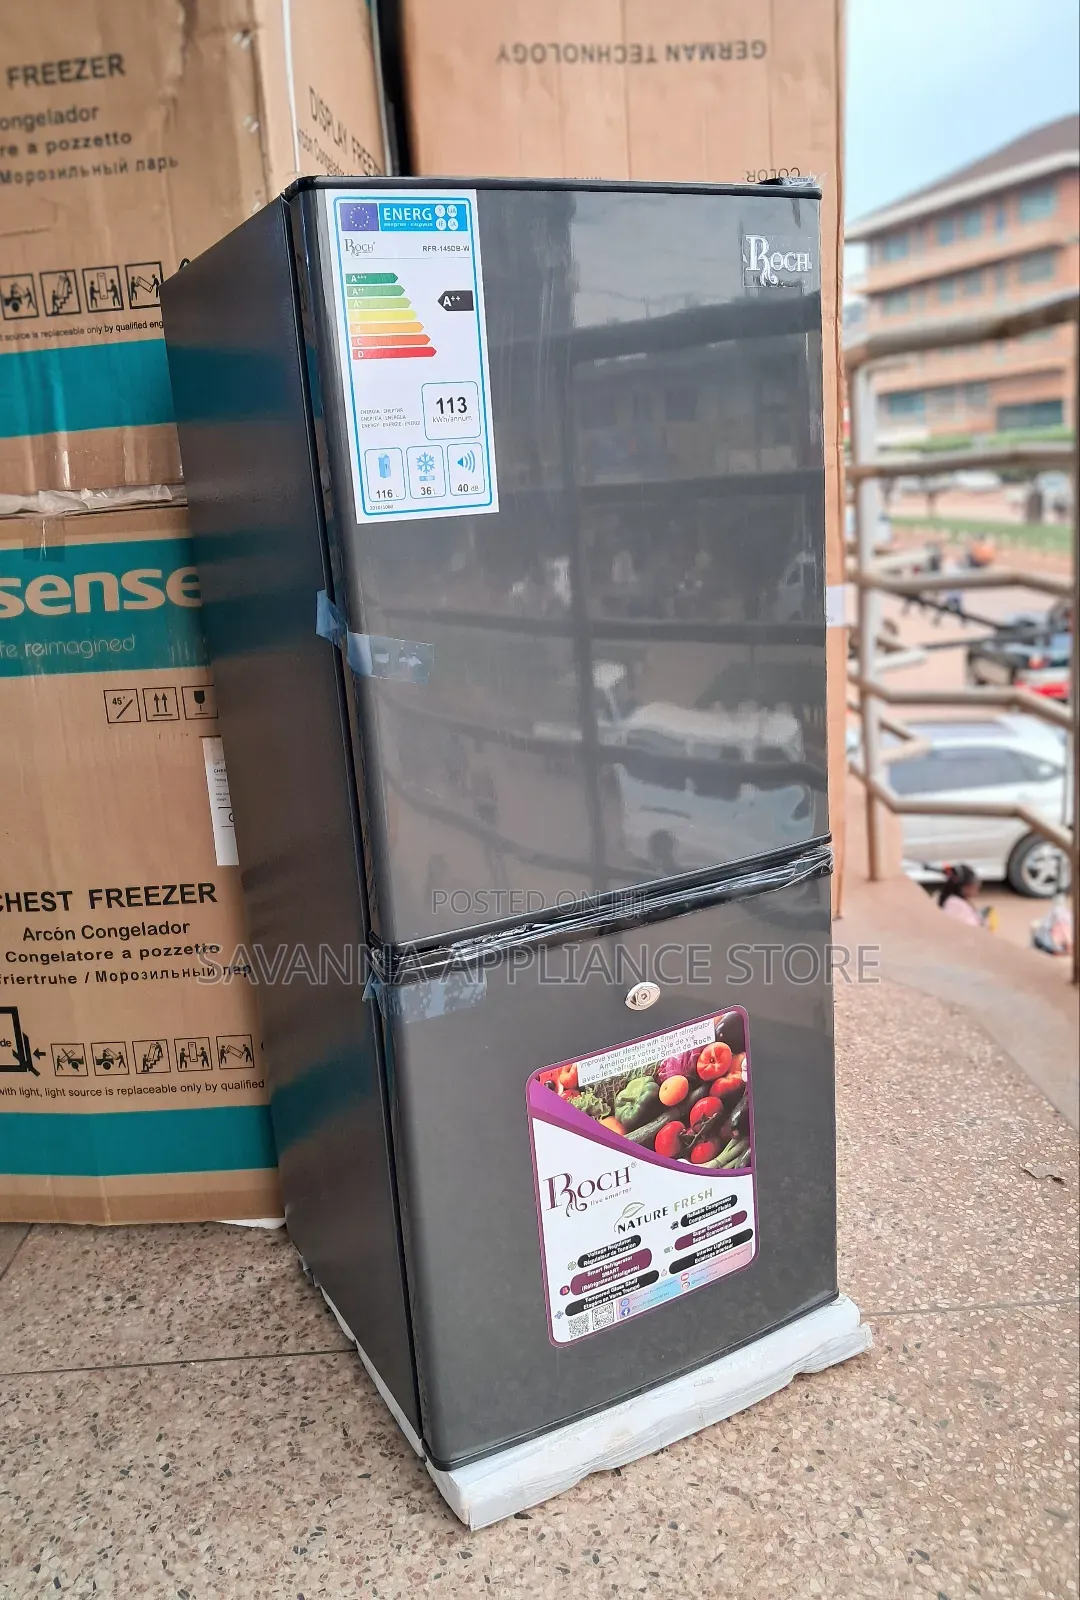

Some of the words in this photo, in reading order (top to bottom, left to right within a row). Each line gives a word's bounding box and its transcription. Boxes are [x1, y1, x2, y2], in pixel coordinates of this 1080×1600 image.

[495, 43, 658, 65] TECHNOLOGY
[666, 39, 766, 62] GERMAN
[6, 54, 126, 88] FREEZER
[308, 84, 348, 155] DISPLAY
[27, 142, 38, 155] a
[46, 132, 132, 156] pozzetto
[384, 208, 432, 220] ENERG
[352, 287, 364, 295] A++
[443, 296, 460, 306] A++
[41, 327, 85, 338] replaceable
[87, 325, 102, 335] only
[104, 323, 114, 334] by
[116, 320, 148, 332] qualified
[356, 338, 362, 346] C
[436, 396, 468, 414] 113
[376, 489, 393, 498] 116
[420, 486, 432, 496] 36
[458, 484, 468, 492] 40
[470, 484, 479, 492] dB
[0, 566, 202, 618] sense
[24, 633, 136, 658] reimagined
[0, 891, 73, 912] HEST
[88, 882, 218, 910] FREEZER
[22, 926, 76, 942] Arcón
[81, 921, 190, 941] Congelador
[6, 950, 114, 965] Congelatore
[122, 950, 132, 960] a
[140, 943, 220, 965] pozzetto
[96, 963, 214, 984] Морозильный
[599, 1054, 636, 1070] Améliorez
[638, 1048, 656, 1058] votre
[658, 1042, 674, 1052] style
[676, 1038, 684, 1046] de
[686, 1034, 695, 1042] vie
[607, 1051, 620, 1060] your
[646, 1038, 658, 1048] with
[660, 1032, 678, 1042] Smart
[582, 1073, 600, 1084] avec
[602, 1069, 612, 1078] les
[660, 1047, 682, 1058] Smart
[682, 1042, 692, 1050] de
[694, 1036, 712, 1046] Roch
[19, 1086, 42, 1098] light,
[44, 1086, 66, 1098] light
[68, 1088, 102, 1097] source
[106, 1086, 114, 1096] is
[116, 1084, 177, 1097] replaceable
[180, 1082, 202, 1094] only
[204, 1082, 218, 1093] by
[220, 1078, 265, 1092] qualified
[604, 1187, 632, 1200] smarter
[617, 1206, 668, 1234] NATURE
[673, 1188, 713, 1212] FRESH
[587, 1266, 602, 1276] Smart
[602, 1266, 620, 1278] SMART
[585, 1288, 610, 1302] Tempered
[625, 1278, 638, 1287] Shelf
